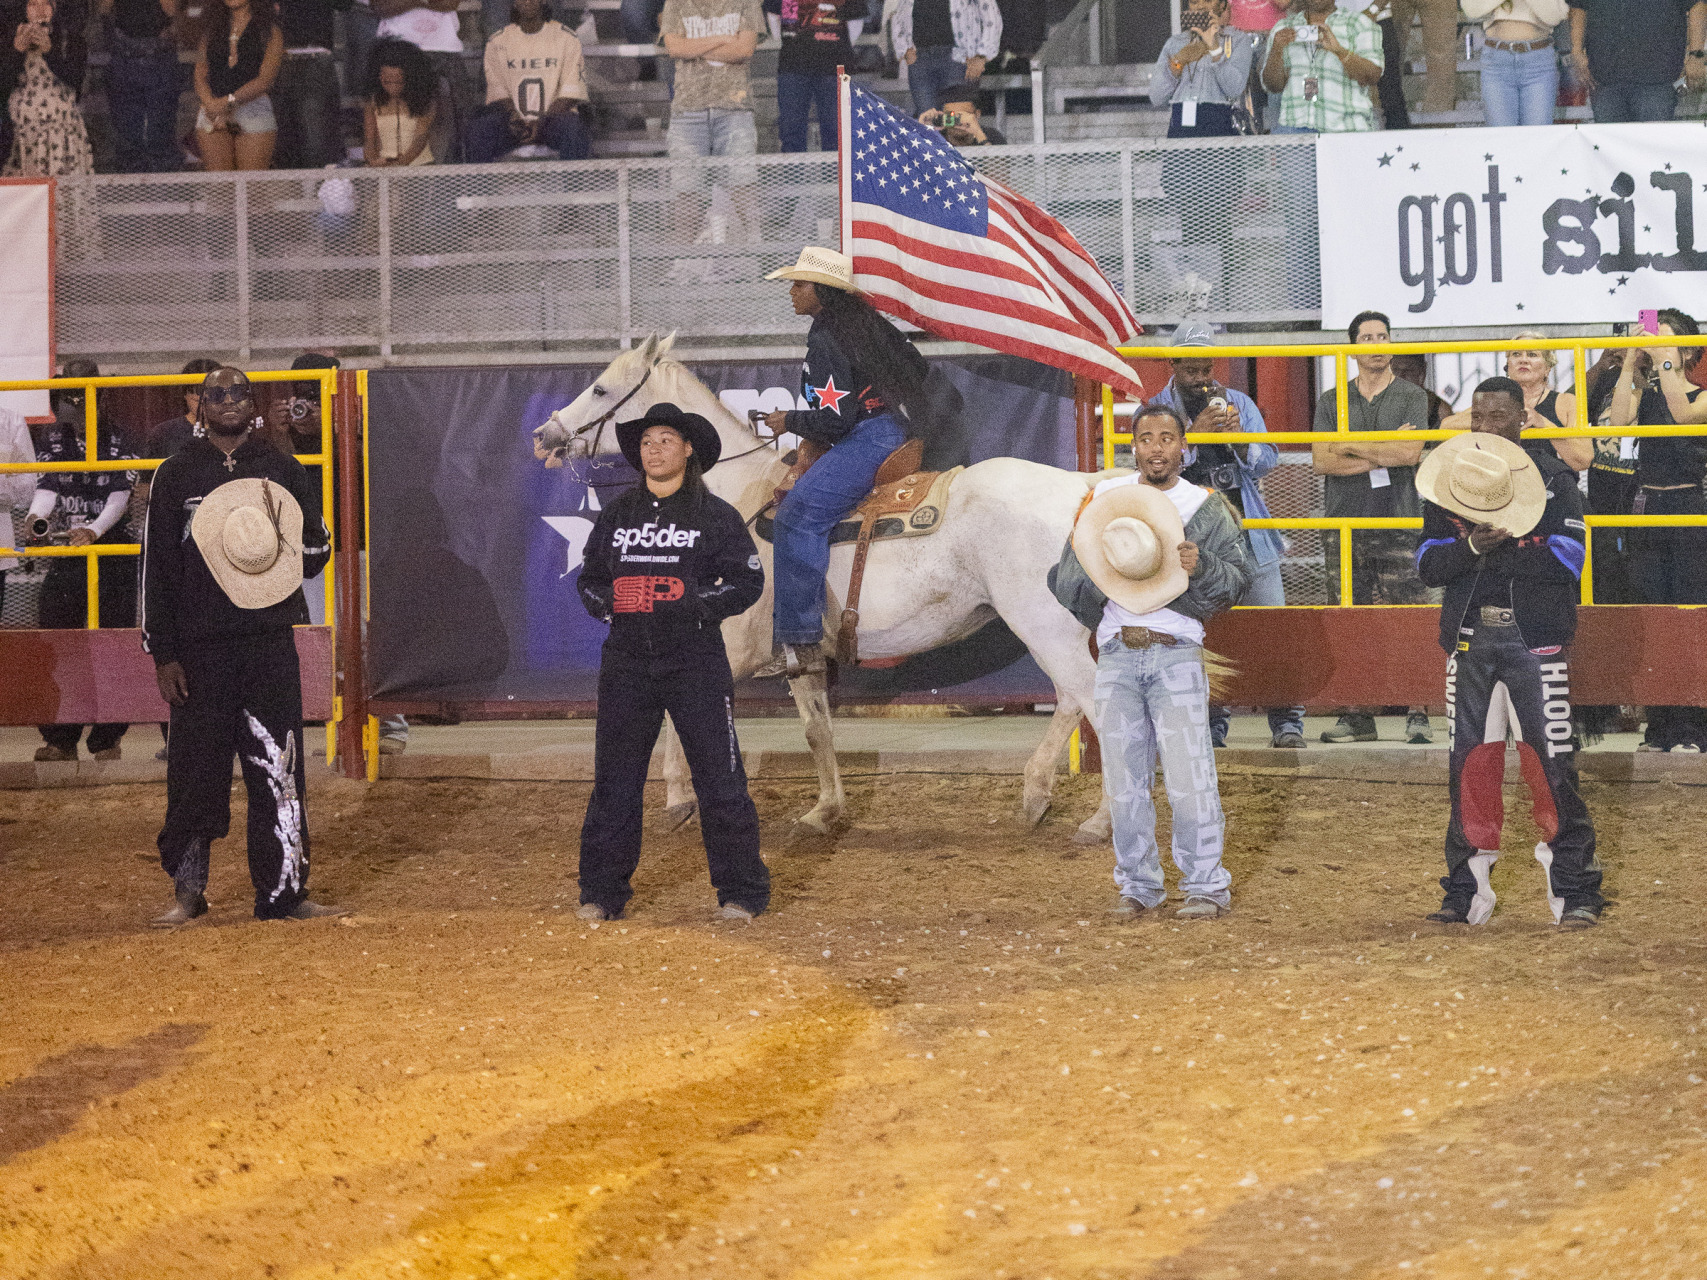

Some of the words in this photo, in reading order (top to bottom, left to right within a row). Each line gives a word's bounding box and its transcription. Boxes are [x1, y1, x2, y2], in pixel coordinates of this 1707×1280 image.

[1397, 165, 1507, 313] got
[612, 523, 700, 554] sp5der
[1540, 662, 1574, 758] TOOTH
